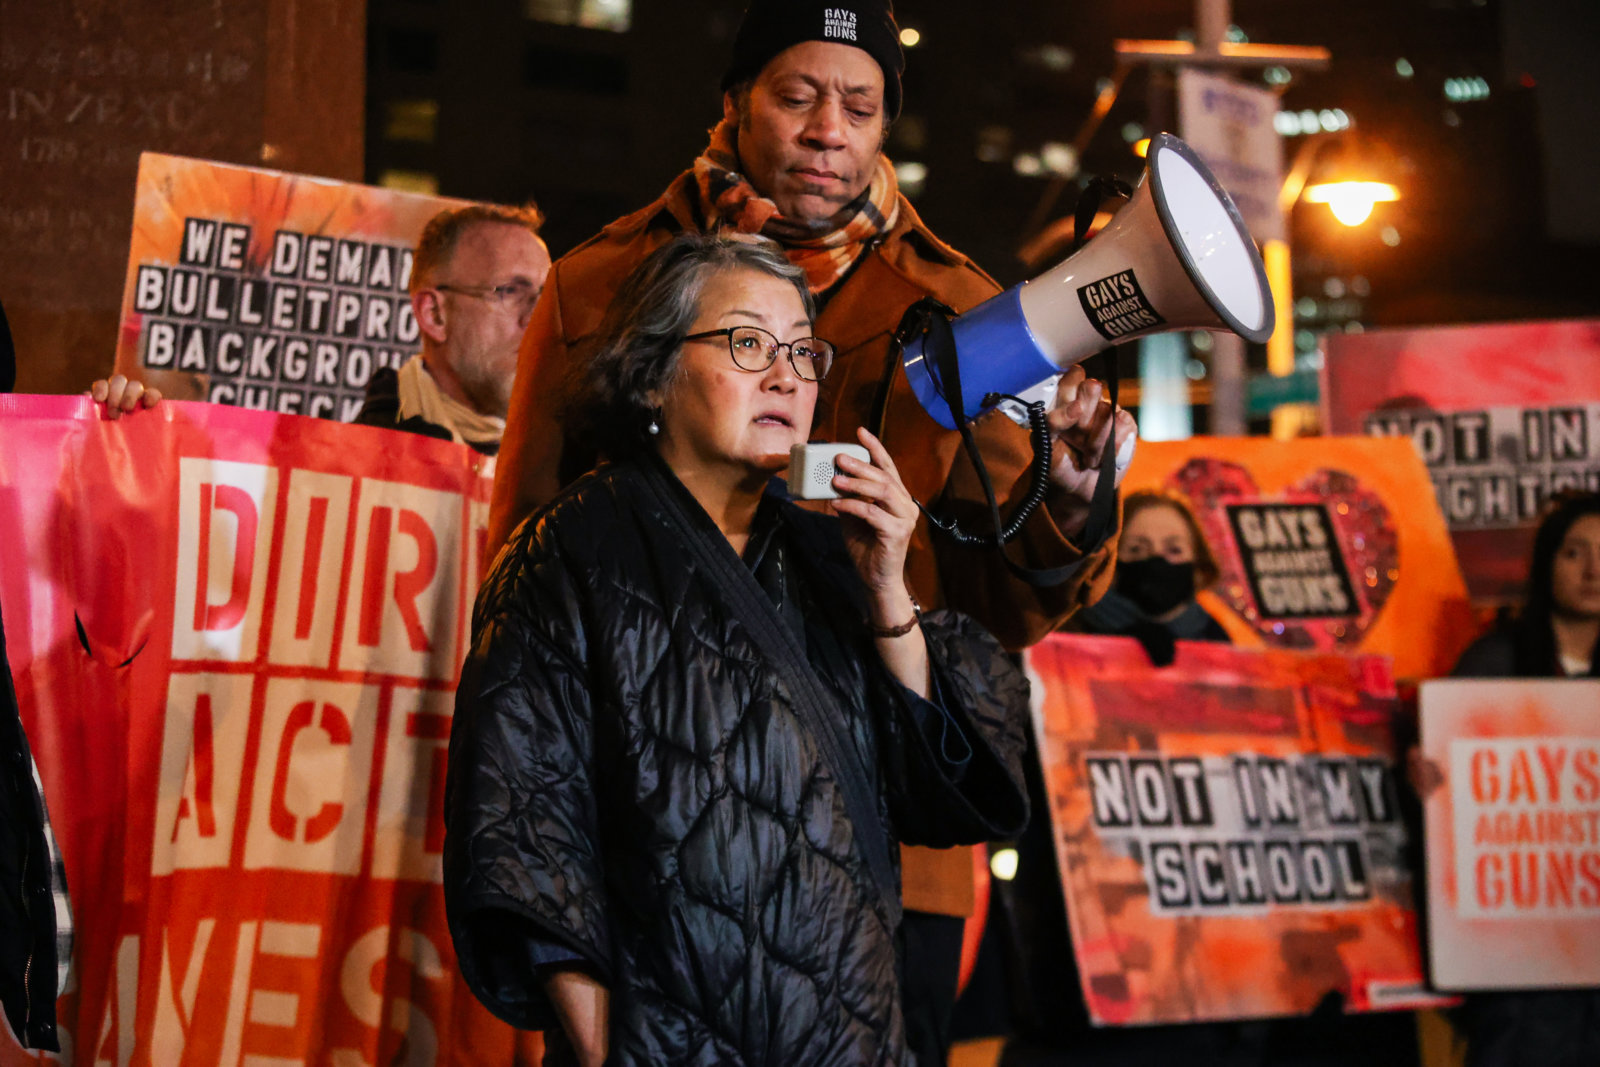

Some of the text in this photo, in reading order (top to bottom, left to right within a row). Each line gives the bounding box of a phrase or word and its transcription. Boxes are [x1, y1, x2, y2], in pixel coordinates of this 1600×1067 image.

[824, 8, 857, 23] GAYS
[824, 26, 857, 41] GUNS
[187, 220, 247, 269] WE
[137, 268, 420, 342] BULLETPRO
[1085, 273, 1135, 309] GAYS
[1096, 296, 1142, 323] AGAINST
[1104, 309, 1158, 337] GUNS
[1528, 414, 1575, 457] IN
[1237, 509, 1327, 549] GAYS
[193, 484, 490, 652] DIR
[1090, 762, 1386, 822] NOT IN MY
[1471, 746, 1600, 804] GAYS
[1475, 811, 1600, 846] AGAINST
[1156, 846, 1366, 901] SCHOOL
[1475, 852, 1600, 909] GUNS
[57, 918, 444, 1067] AVES
